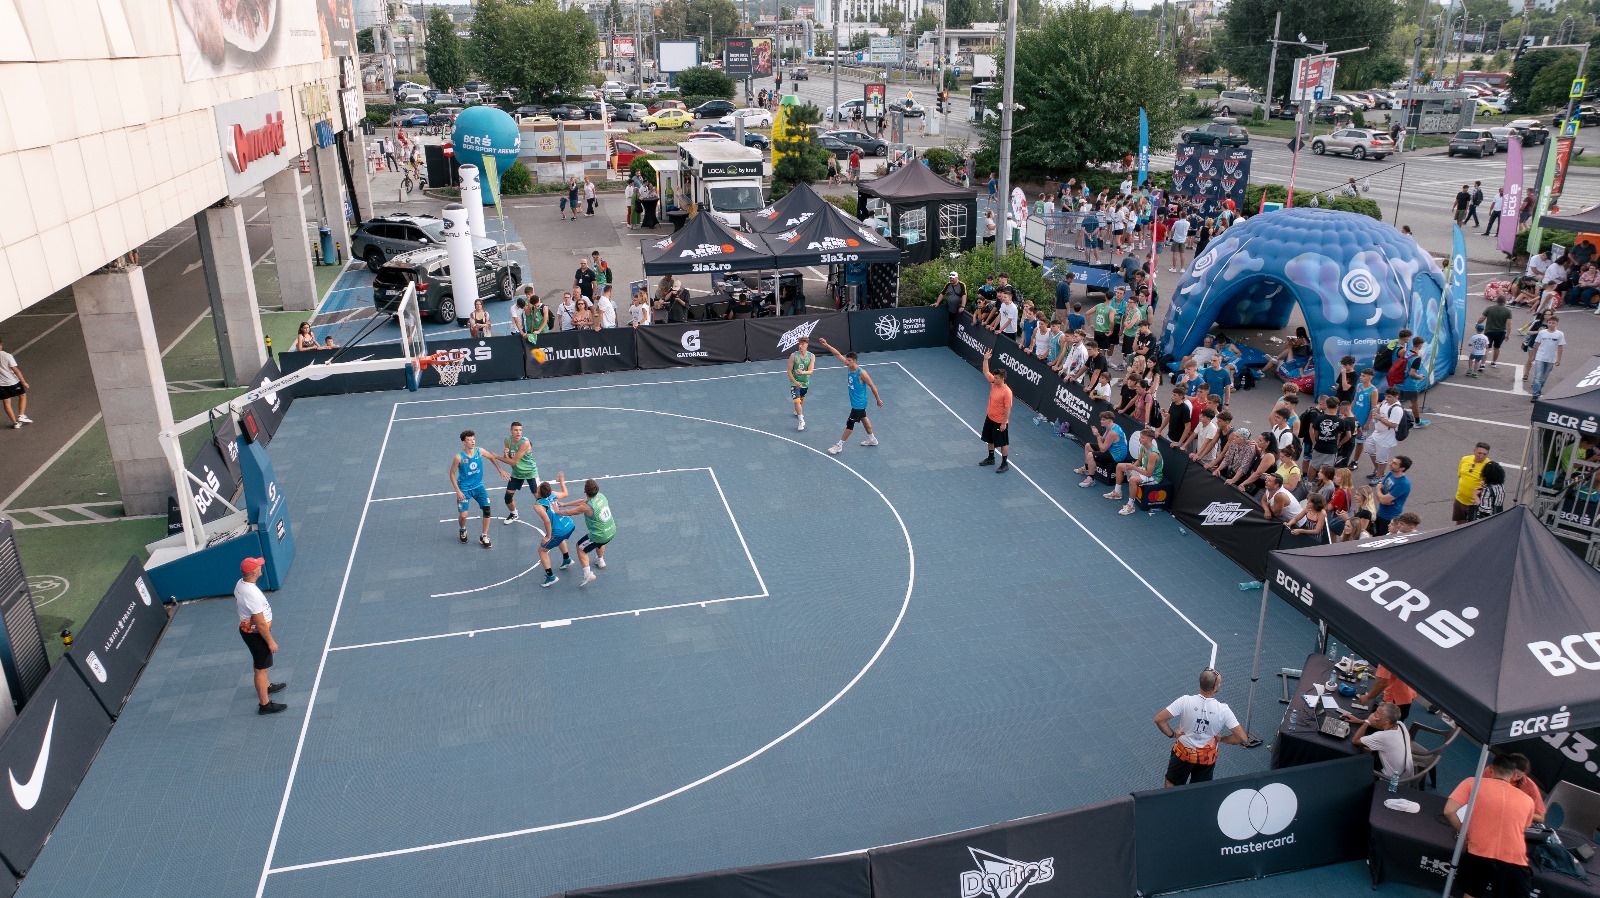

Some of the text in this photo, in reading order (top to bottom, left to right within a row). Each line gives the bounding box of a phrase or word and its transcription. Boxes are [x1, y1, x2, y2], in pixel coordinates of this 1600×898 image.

[464, 135, 480, 145] BCR
[475, 145, 497, 153] SPORT
[1001, 353, 1043, 385] EUROSPORT
[1547, 412, 1579, 430] BCR
[1276, 568, 1300, 597] BCR
[1346, 566, 1430, 622] BCR
[104, 627, 120, 653] ALBINI
[1509, 715, 1549, 737] BCR
[1220, 833, 1295, 856] mastercard
[960, 857, 1055, 898] Doritos
